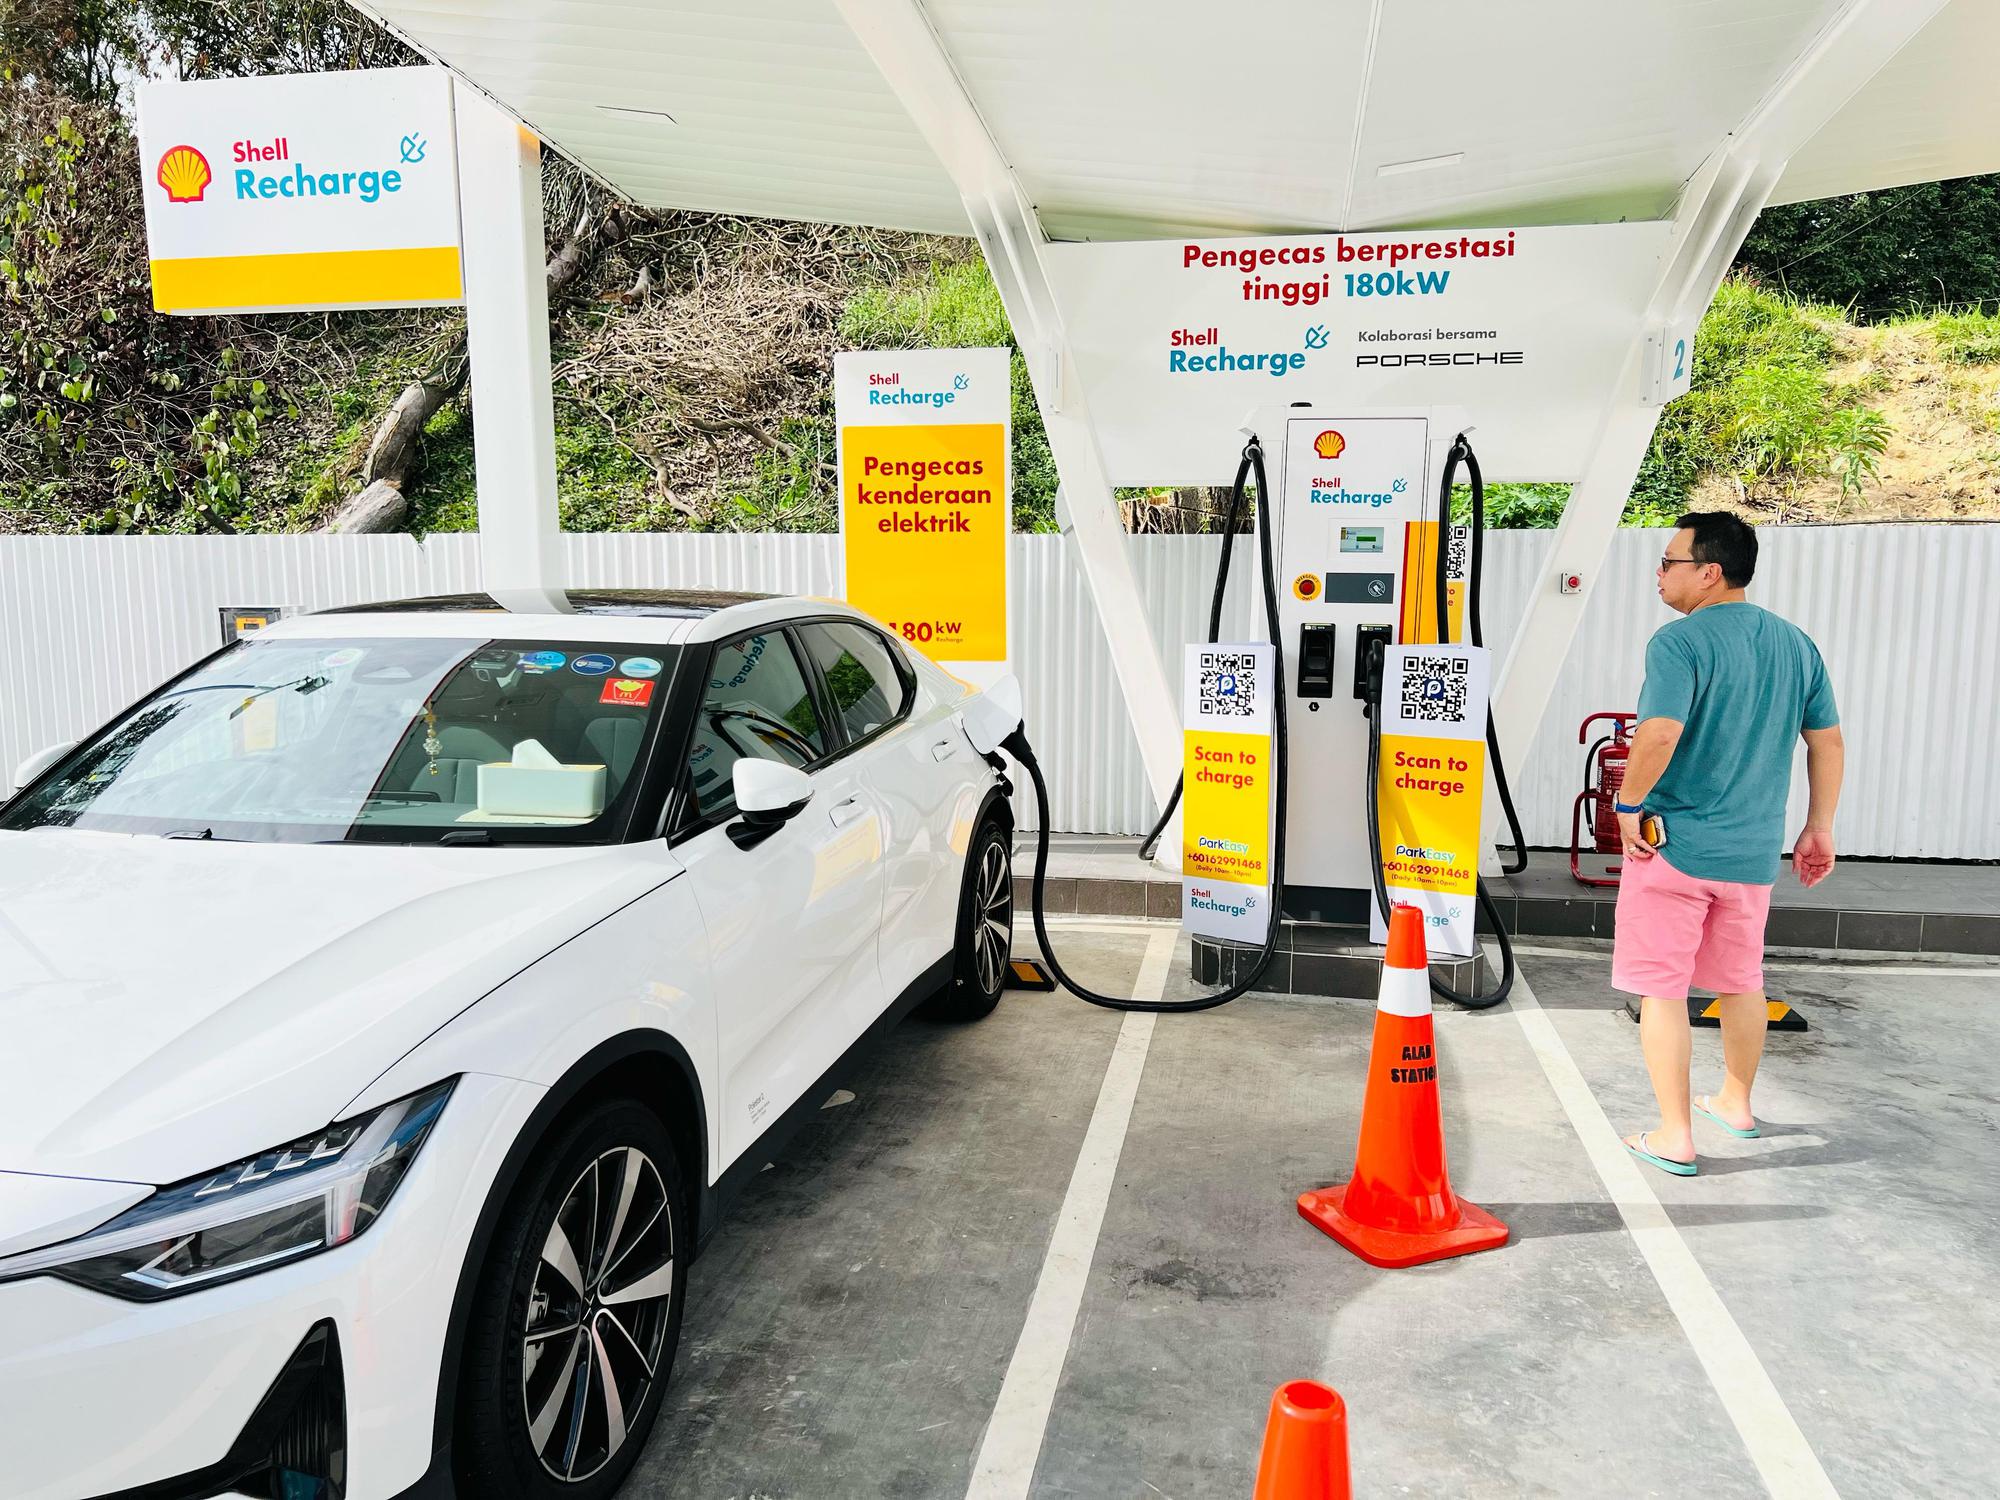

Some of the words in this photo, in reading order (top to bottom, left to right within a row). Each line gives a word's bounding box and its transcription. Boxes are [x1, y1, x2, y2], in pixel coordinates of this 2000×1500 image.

[232, 137, 289, 163] Shell
[234, 163, 402, 203] Recharge
[1183, 245, 1325, 273] Pengecas
[1337, 231, 1515, 268] berprestasi
[1242, 273, 1329, 306] tinggi
[1344, 270, 1450, 297] 180kW
[1170, 327, 1218, 346] Shell
[1358, 329, 1432, 342] Kolaborasi
[1436, 328, 1497, 340] bersama
[1169, 346, 1306, 376] Recharge
[1356, 351, 1524, 368] PORSCHE
[1672, 339, 1685, 381] 2
[869, 373, 899, 385] Shell
[869, 388, 955, 408] Recharge
[864, 456, 984, 481] Pengecas
[1311, 478, 1341, 488] Shell
[858, 483, 991, 504] kenderaan
[1310, 489, 1393, 508] Recharge
[878, 511, 971, 532] elektrik
[935, 620, 962, 634] kW
[1195, 746, 1233, 763] Scan
[1239, 751, 1256, 765] to
[1395, 751, 1441, 769] Scan
[1448, 757, 1468, 772] to
[1196, 766, 1254, 789] charge
[1395, 772, 1464, 797] charge
[1198, 837, 1249, 854] ParkEasy
[1396, 845, 1455, 863] ParkEasy
[1187, 853, 1262, 870] +60162991468
[1382, 861, 1469, 879] +60162991468
[1191, 888, 1211, 898] Shell
[1389, 898, 1408, 906] hell
[1191, 897, 1246, 917] Recharge
